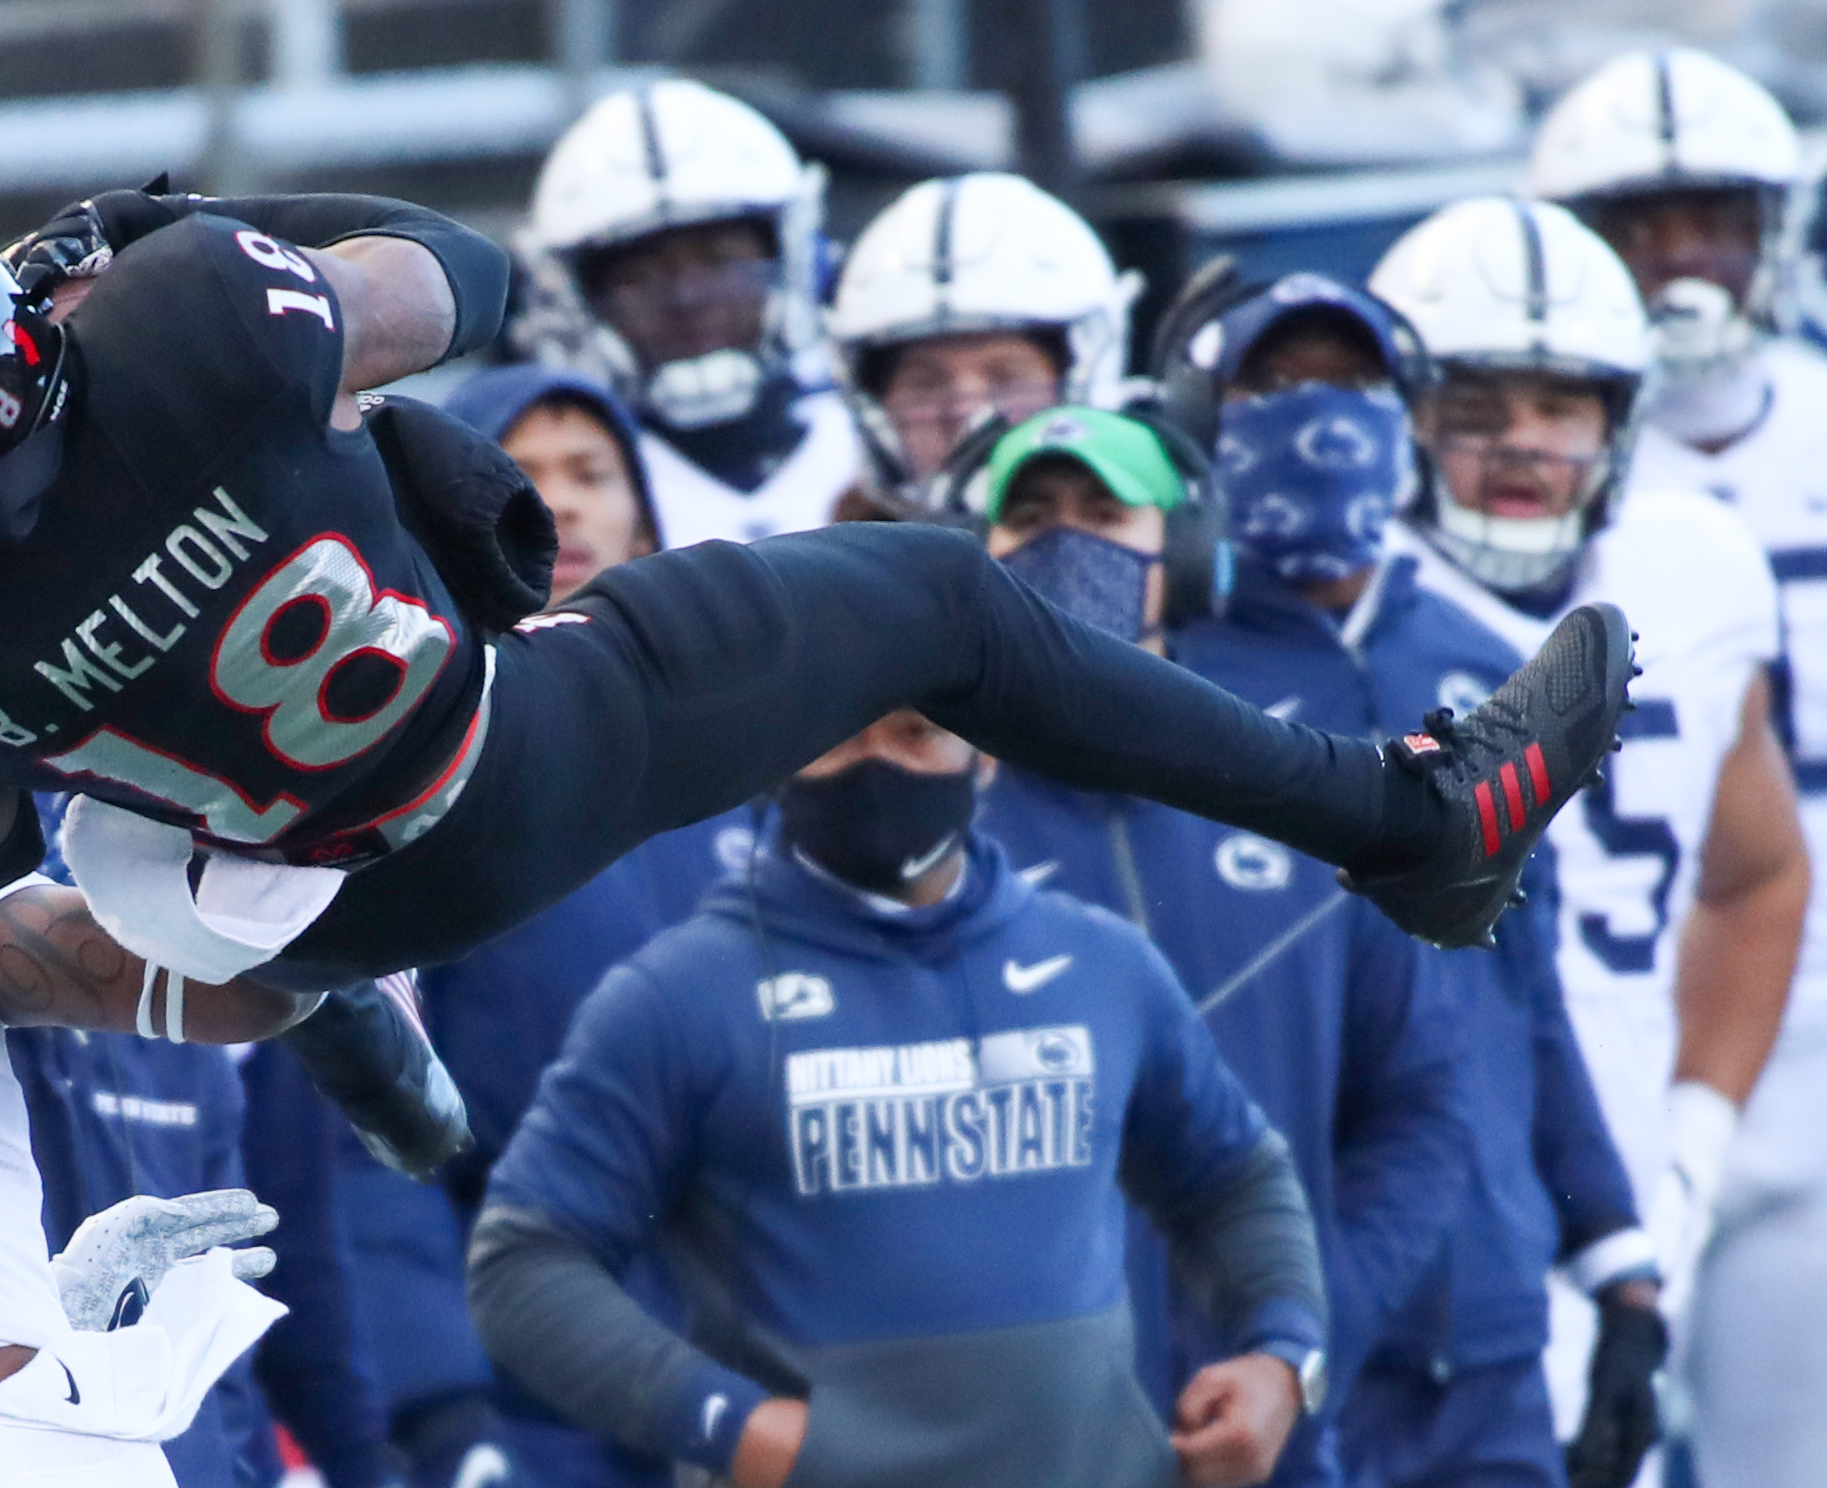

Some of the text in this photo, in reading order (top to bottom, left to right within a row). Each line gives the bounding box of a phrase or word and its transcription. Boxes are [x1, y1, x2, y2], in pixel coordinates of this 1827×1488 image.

[234, 230, 335, 331] 18
[33, 485, 269, 712] MELTON
[36, 530, 458, 845] 18
[791, 1074, 1093, 1195] PENN STATE
